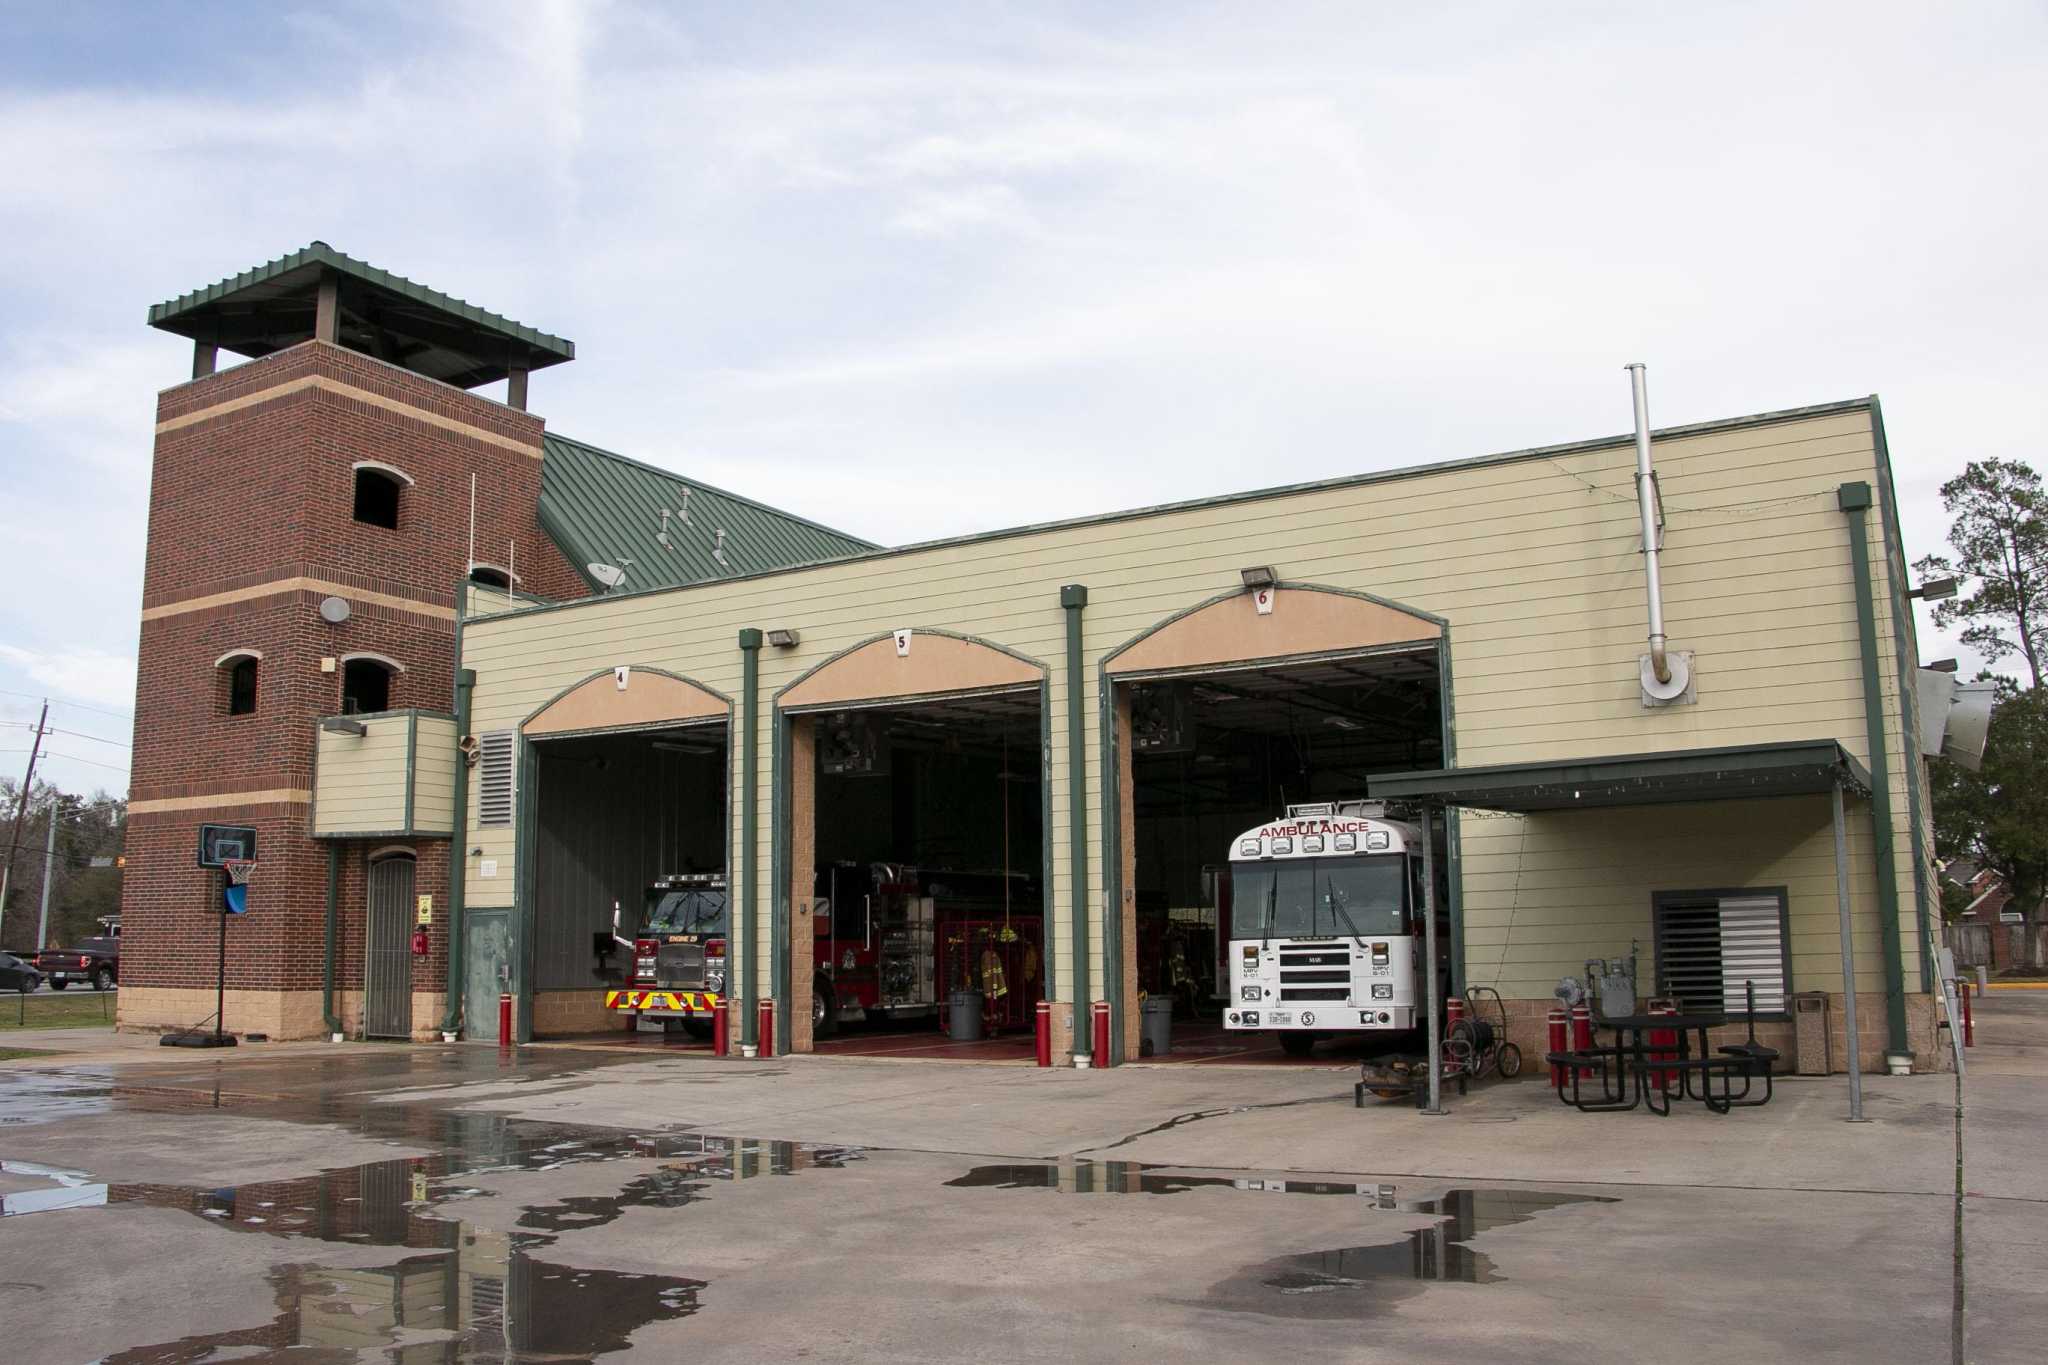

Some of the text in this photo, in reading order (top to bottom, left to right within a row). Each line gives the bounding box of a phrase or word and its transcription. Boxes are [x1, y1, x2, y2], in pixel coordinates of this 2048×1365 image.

[1259, 591, 1267, 604] 6
[898, 636, 905, 648] 5
[617, 672, 623, 682] 4
[1260, 821, 1369, 837] AMBULANCE
